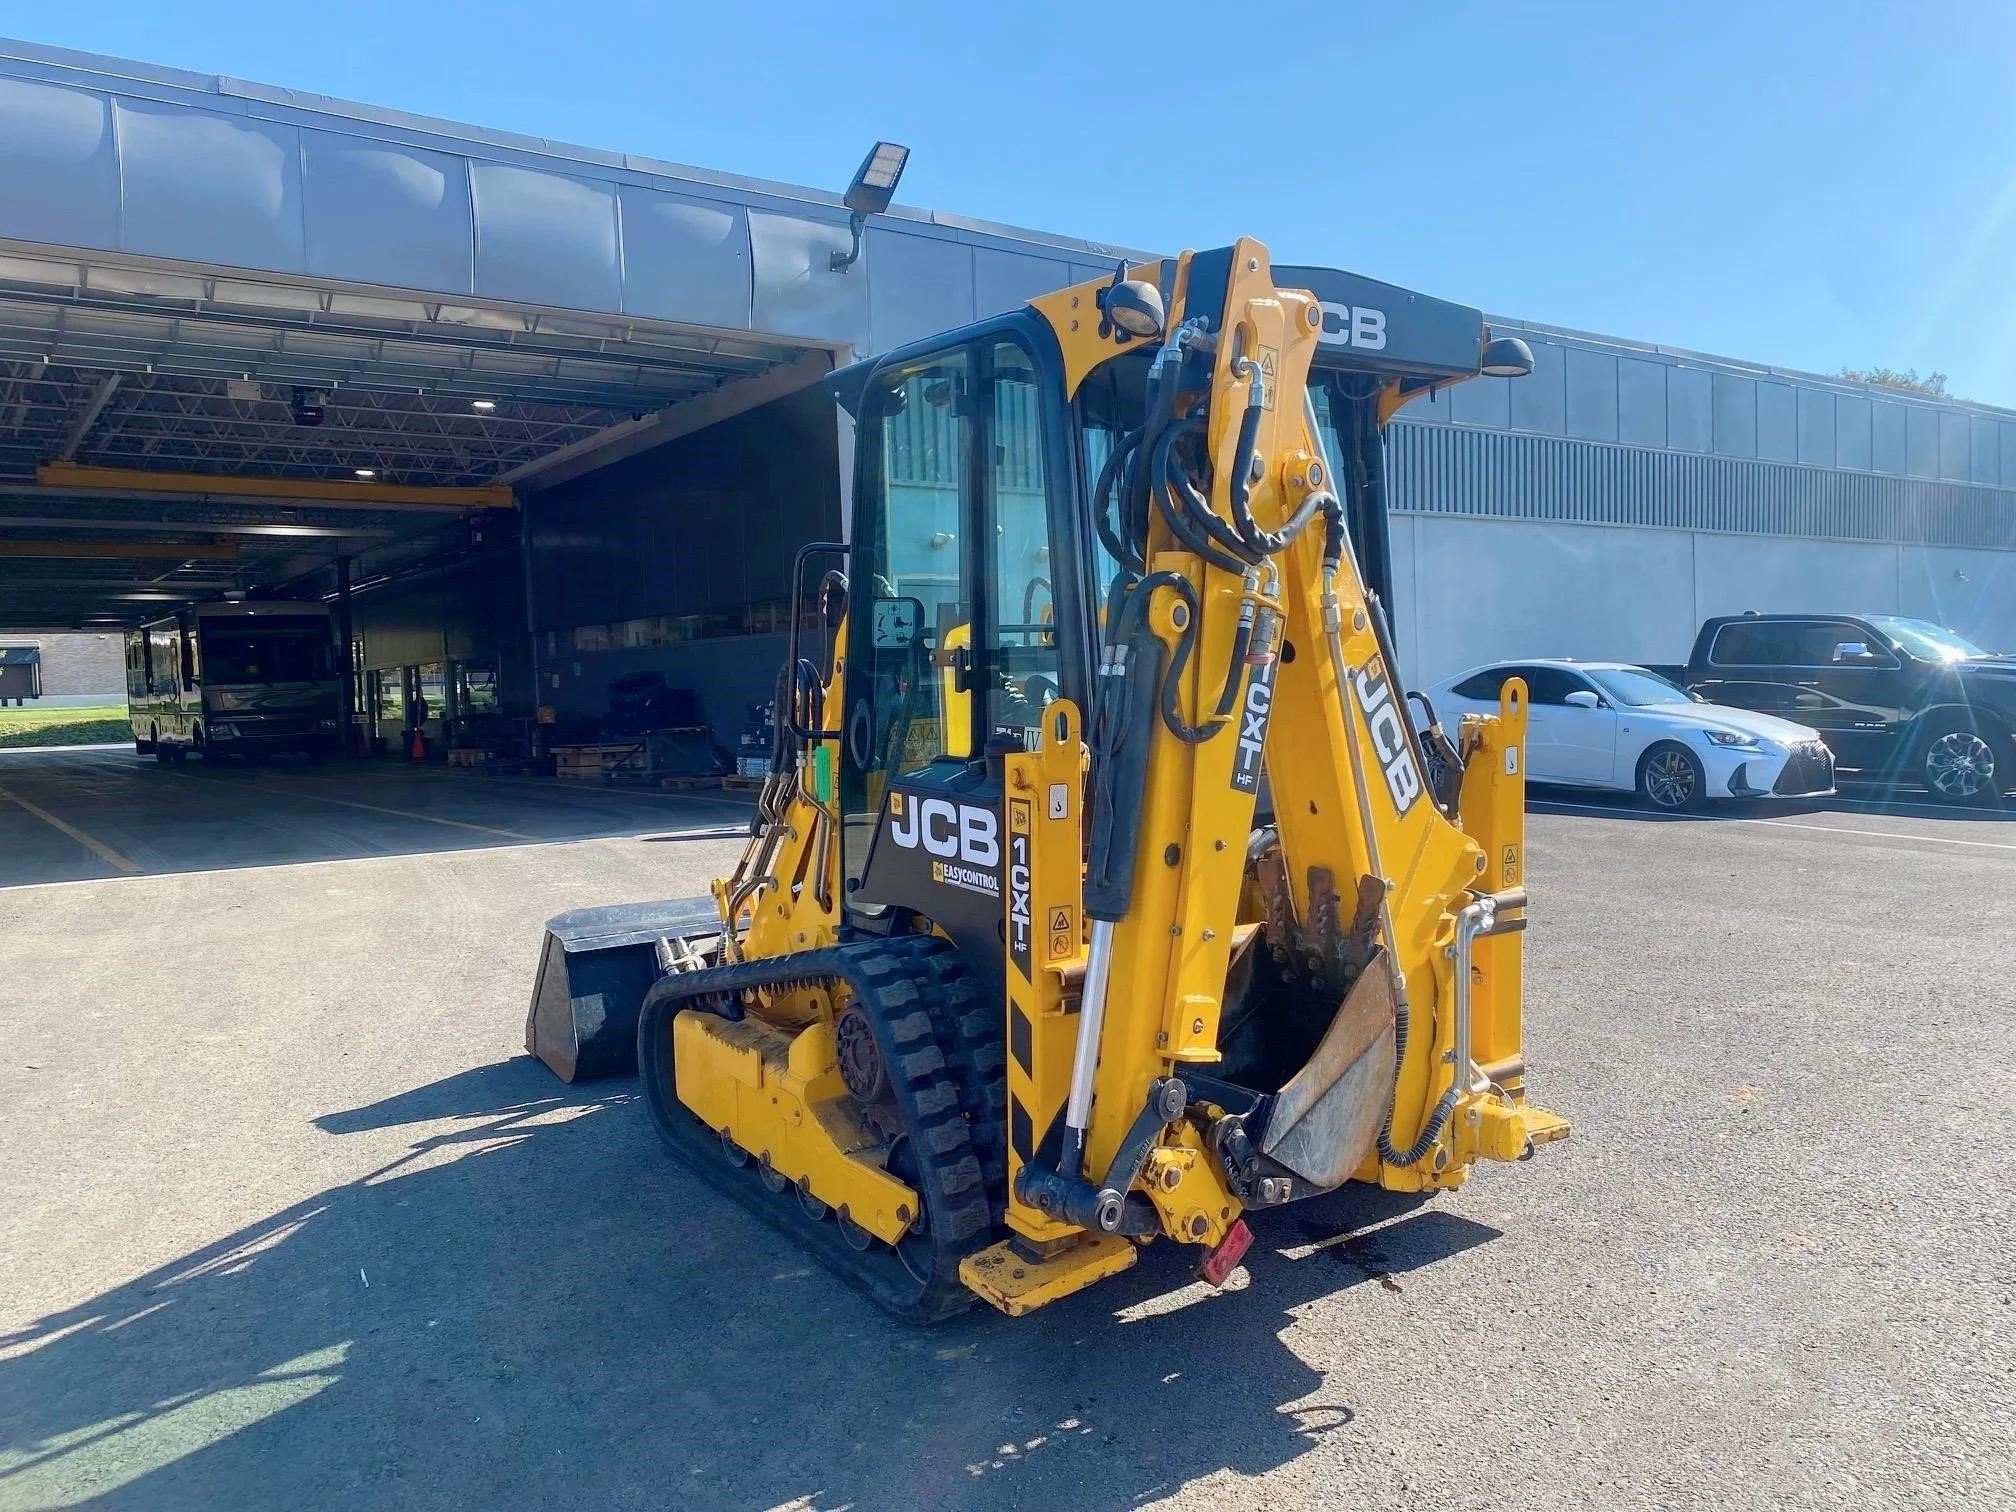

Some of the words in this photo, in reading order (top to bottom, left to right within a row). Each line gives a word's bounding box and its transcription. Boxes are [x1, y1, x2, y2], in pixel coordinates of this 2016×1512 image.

[1318, 301, 1387, 350] CB
[1356, 669, 1419, 812] JCB
[1236, 772, 1253, 787] HF
[891, 795, 1000, 868] JCB
[943, 863, 1000, 891] EASYCONTROL
[1011, 837, 1031, 942] 1CXT
[1014, 941, 1028, 953] HF
